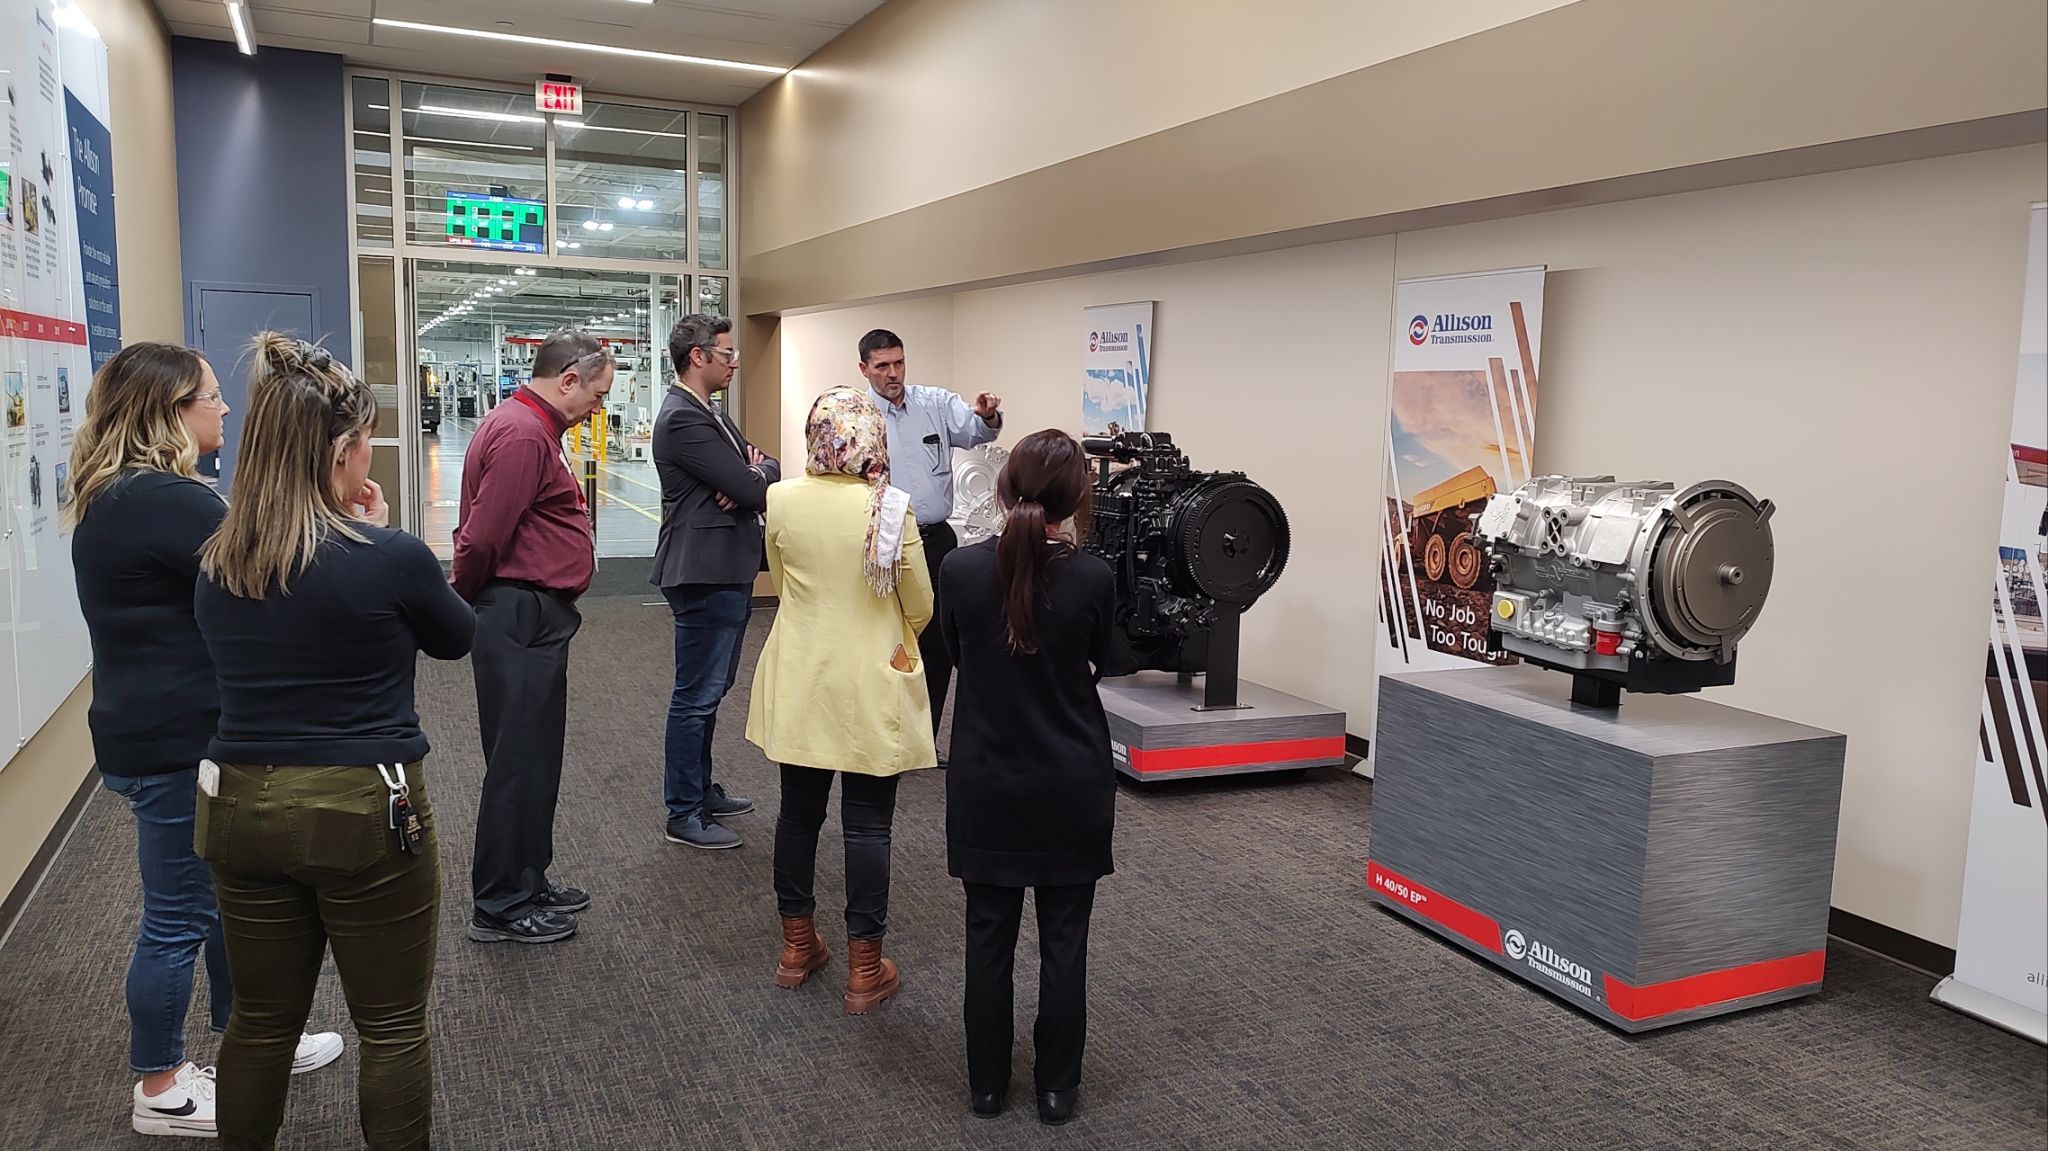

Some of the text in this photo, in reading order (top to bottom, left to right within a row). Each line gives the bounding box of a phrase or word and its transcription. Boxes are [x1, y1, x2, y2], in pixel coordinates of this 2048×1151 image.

[543, 84, 577, 111] EXIT
[72, 126, 84, 163] The
[1430, 314, 1492, 332] Allison
[1099, 331, 1129, 344] Allison
[1431, 334, 1493, 344] Transmission
[1426, 599, 1476, 625] No Job
[1430, 625, 1456, 646] Too
[1375, 873, 1383, 886] H
[1384, 878, 1409, 898] 40/50
[1527, 941, 1592, 986] Allison
[1527, 956, 1592, 997] Transmission
